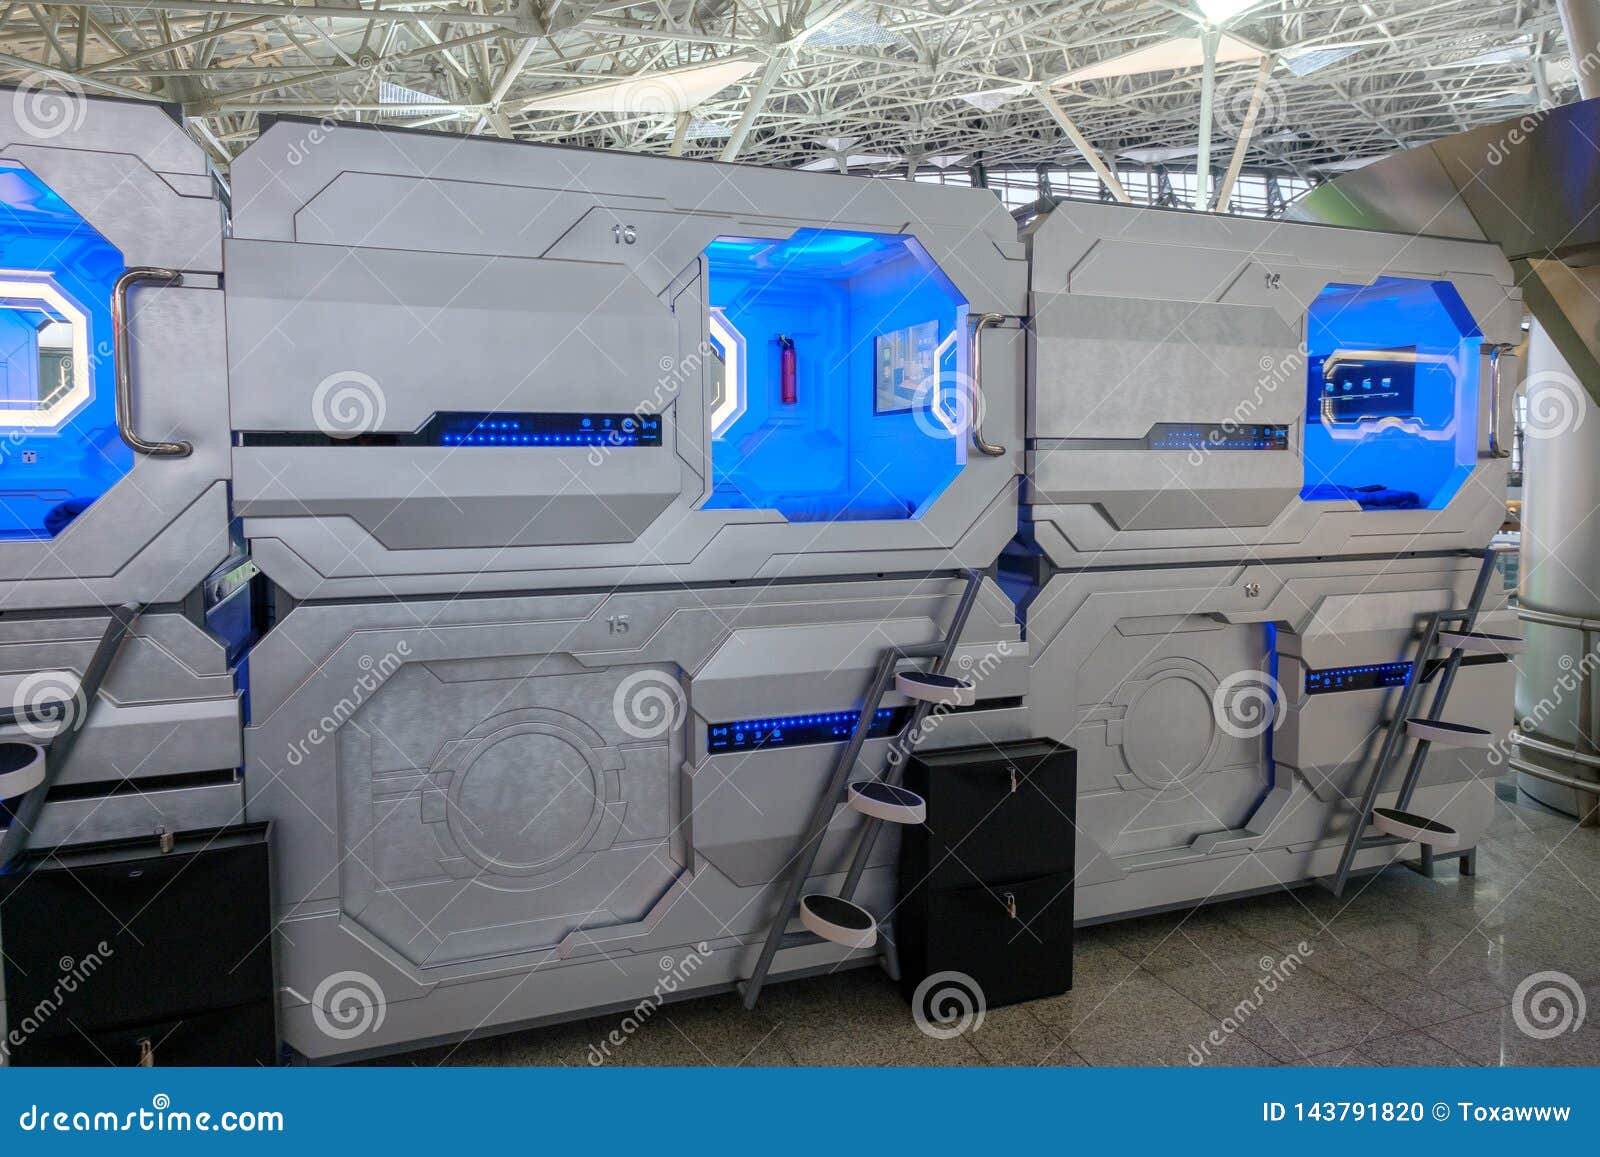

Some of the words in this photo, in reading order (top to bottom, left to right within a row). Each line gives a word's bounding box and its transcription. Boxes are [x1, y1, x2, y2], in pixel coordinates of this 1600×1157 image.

[611, 224, 637, 245] 16
[1264, 273, 1281, 289] 14
[606, 615, 630, 635] 15
